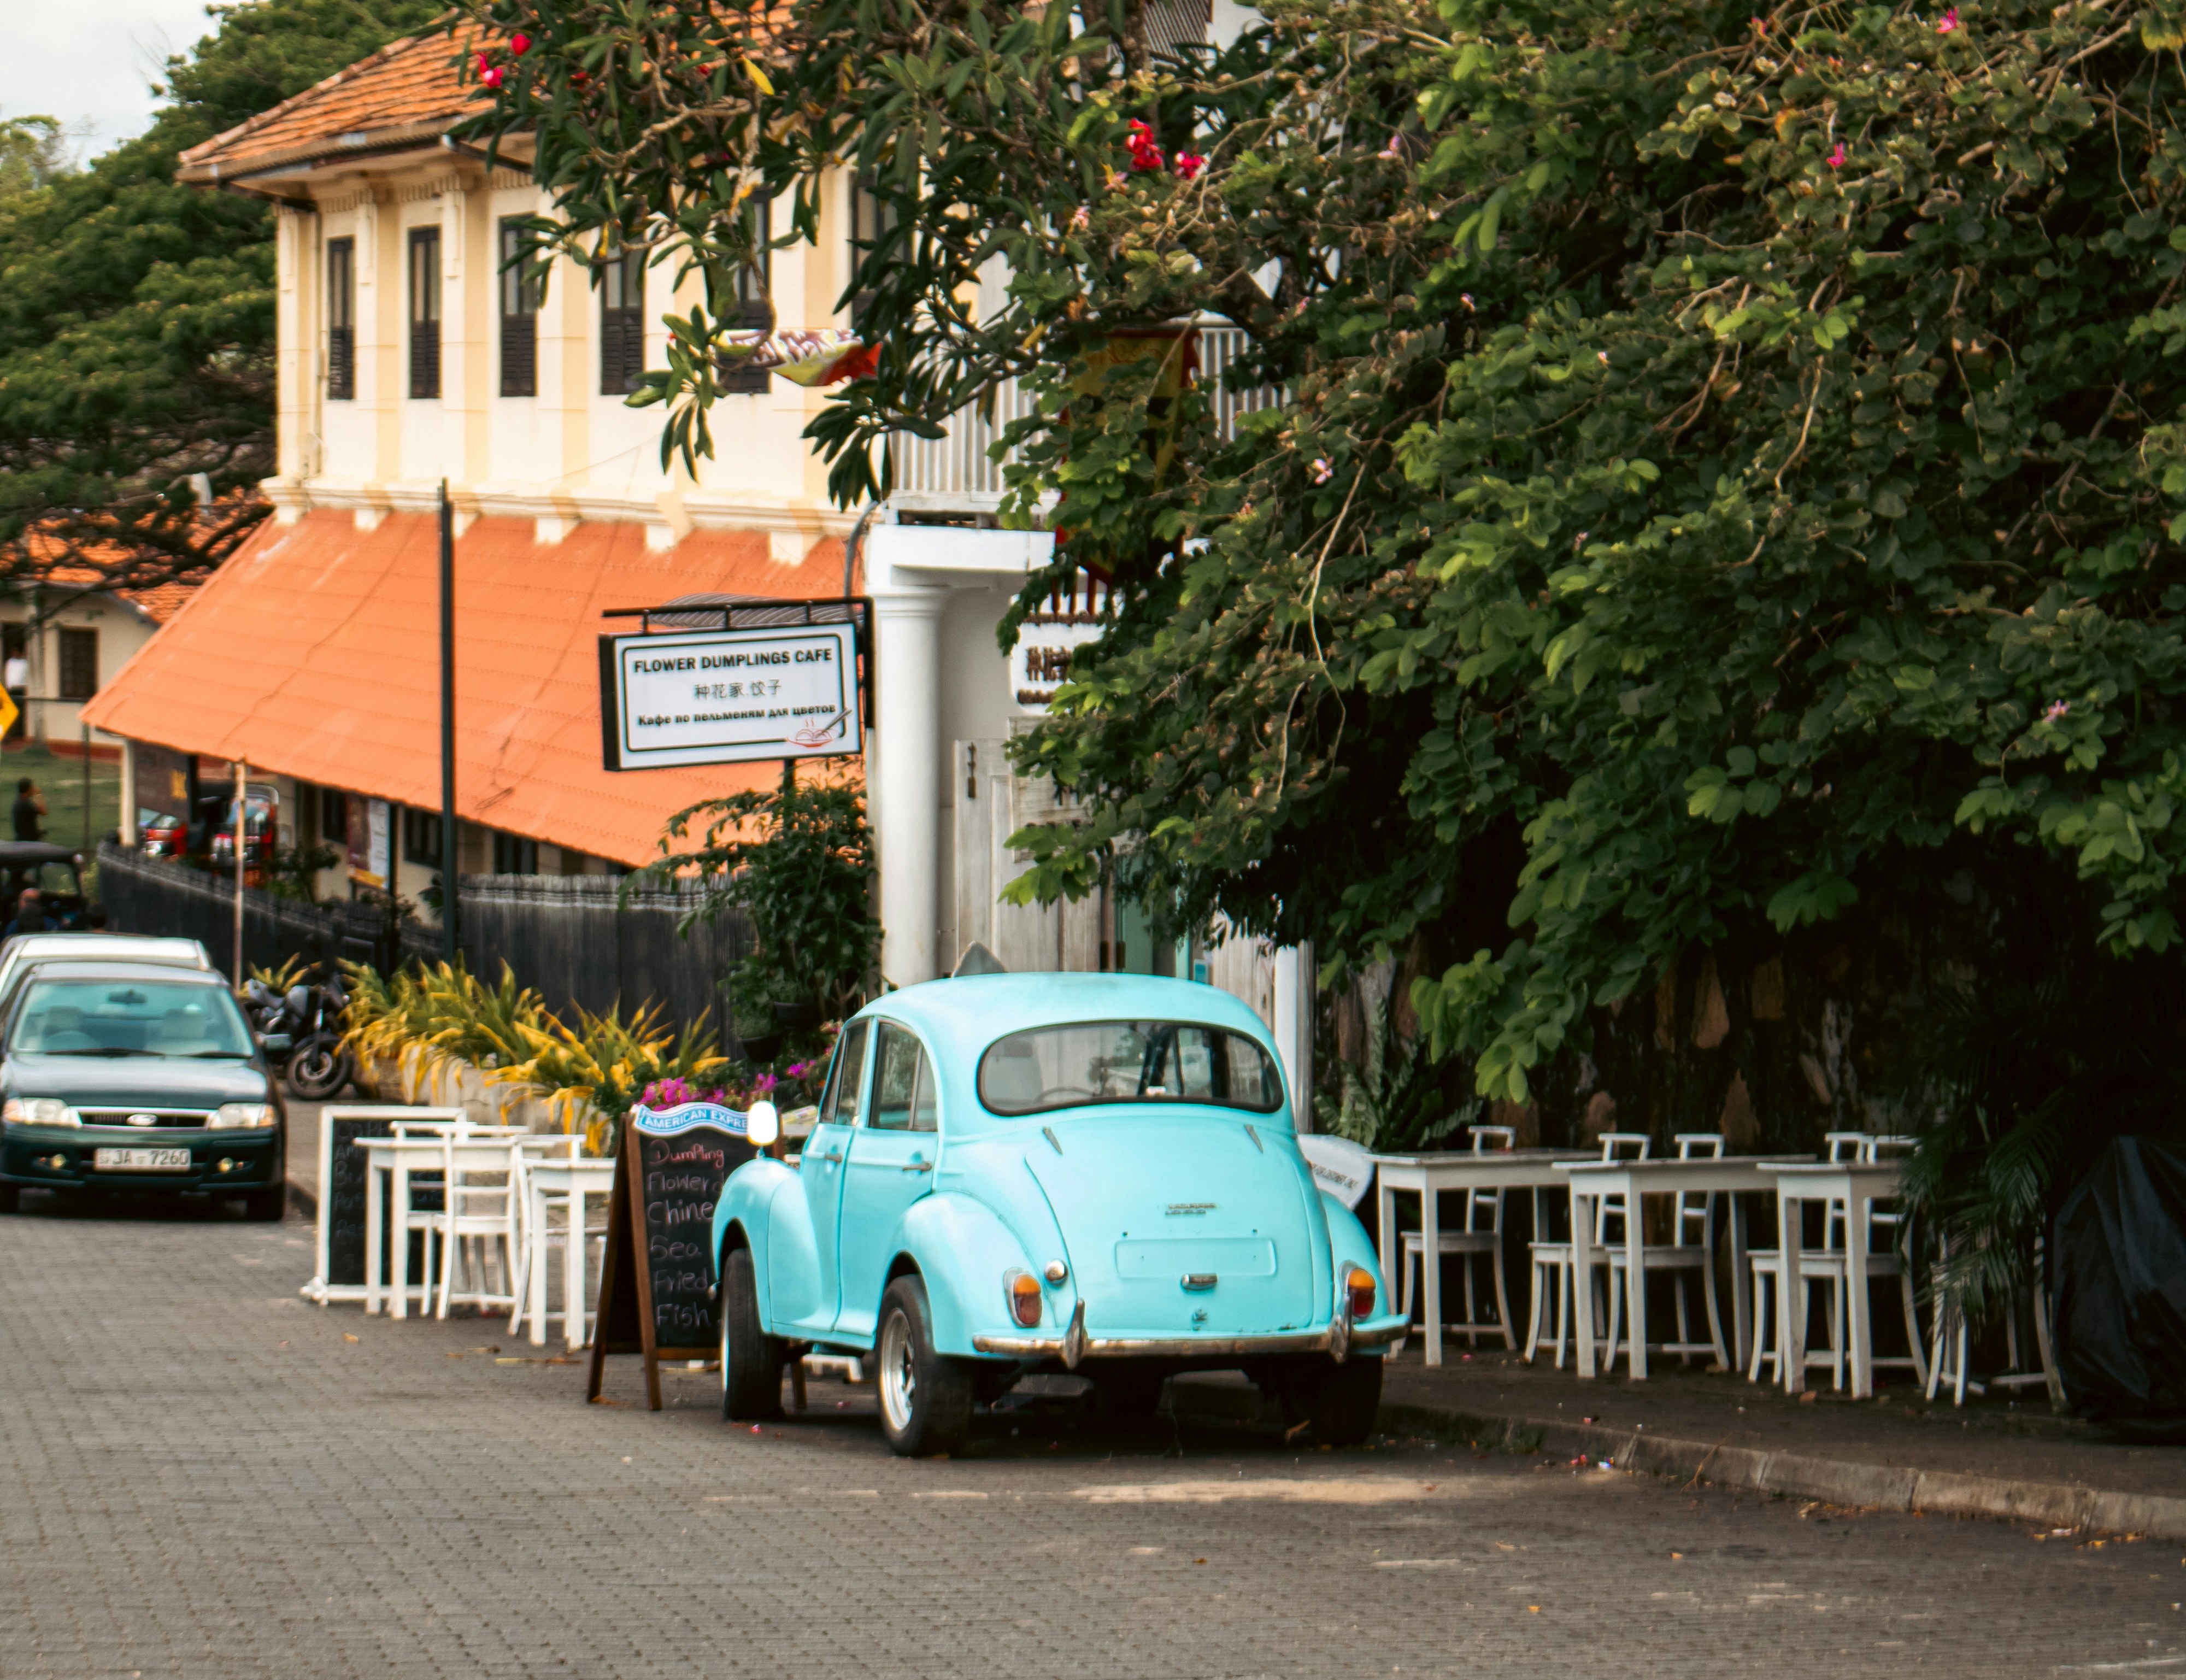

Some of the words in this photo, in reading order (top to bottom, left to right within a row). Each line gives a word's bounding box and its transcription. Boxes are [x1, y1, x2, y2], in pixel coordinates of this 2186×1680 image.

[634, 657, 696, 673] FLOWER
[701, 650, 791, 668] DUMPLINGS
[796, 648, 832, 662] CAFE
[638, 713, 672, 726] Кафе
[675, 714, 690, 723] по
[694, 709, 765, 721] пельменям
[768, 707, 789, 718] для
[793, 704, 836, 716] цветов
[645, 1110, 707, 1128] AMERICAN
[711, 1110, 748, 1128] EXPRE
[113, 1149, 132, 1165] JA
[150, 1149, 190, 1165] 7260
[648, 1199, 714, 1225] Chine
[655, 1267, 708, 1295] Fried
[656, 1301, 711, 1327] Fish
